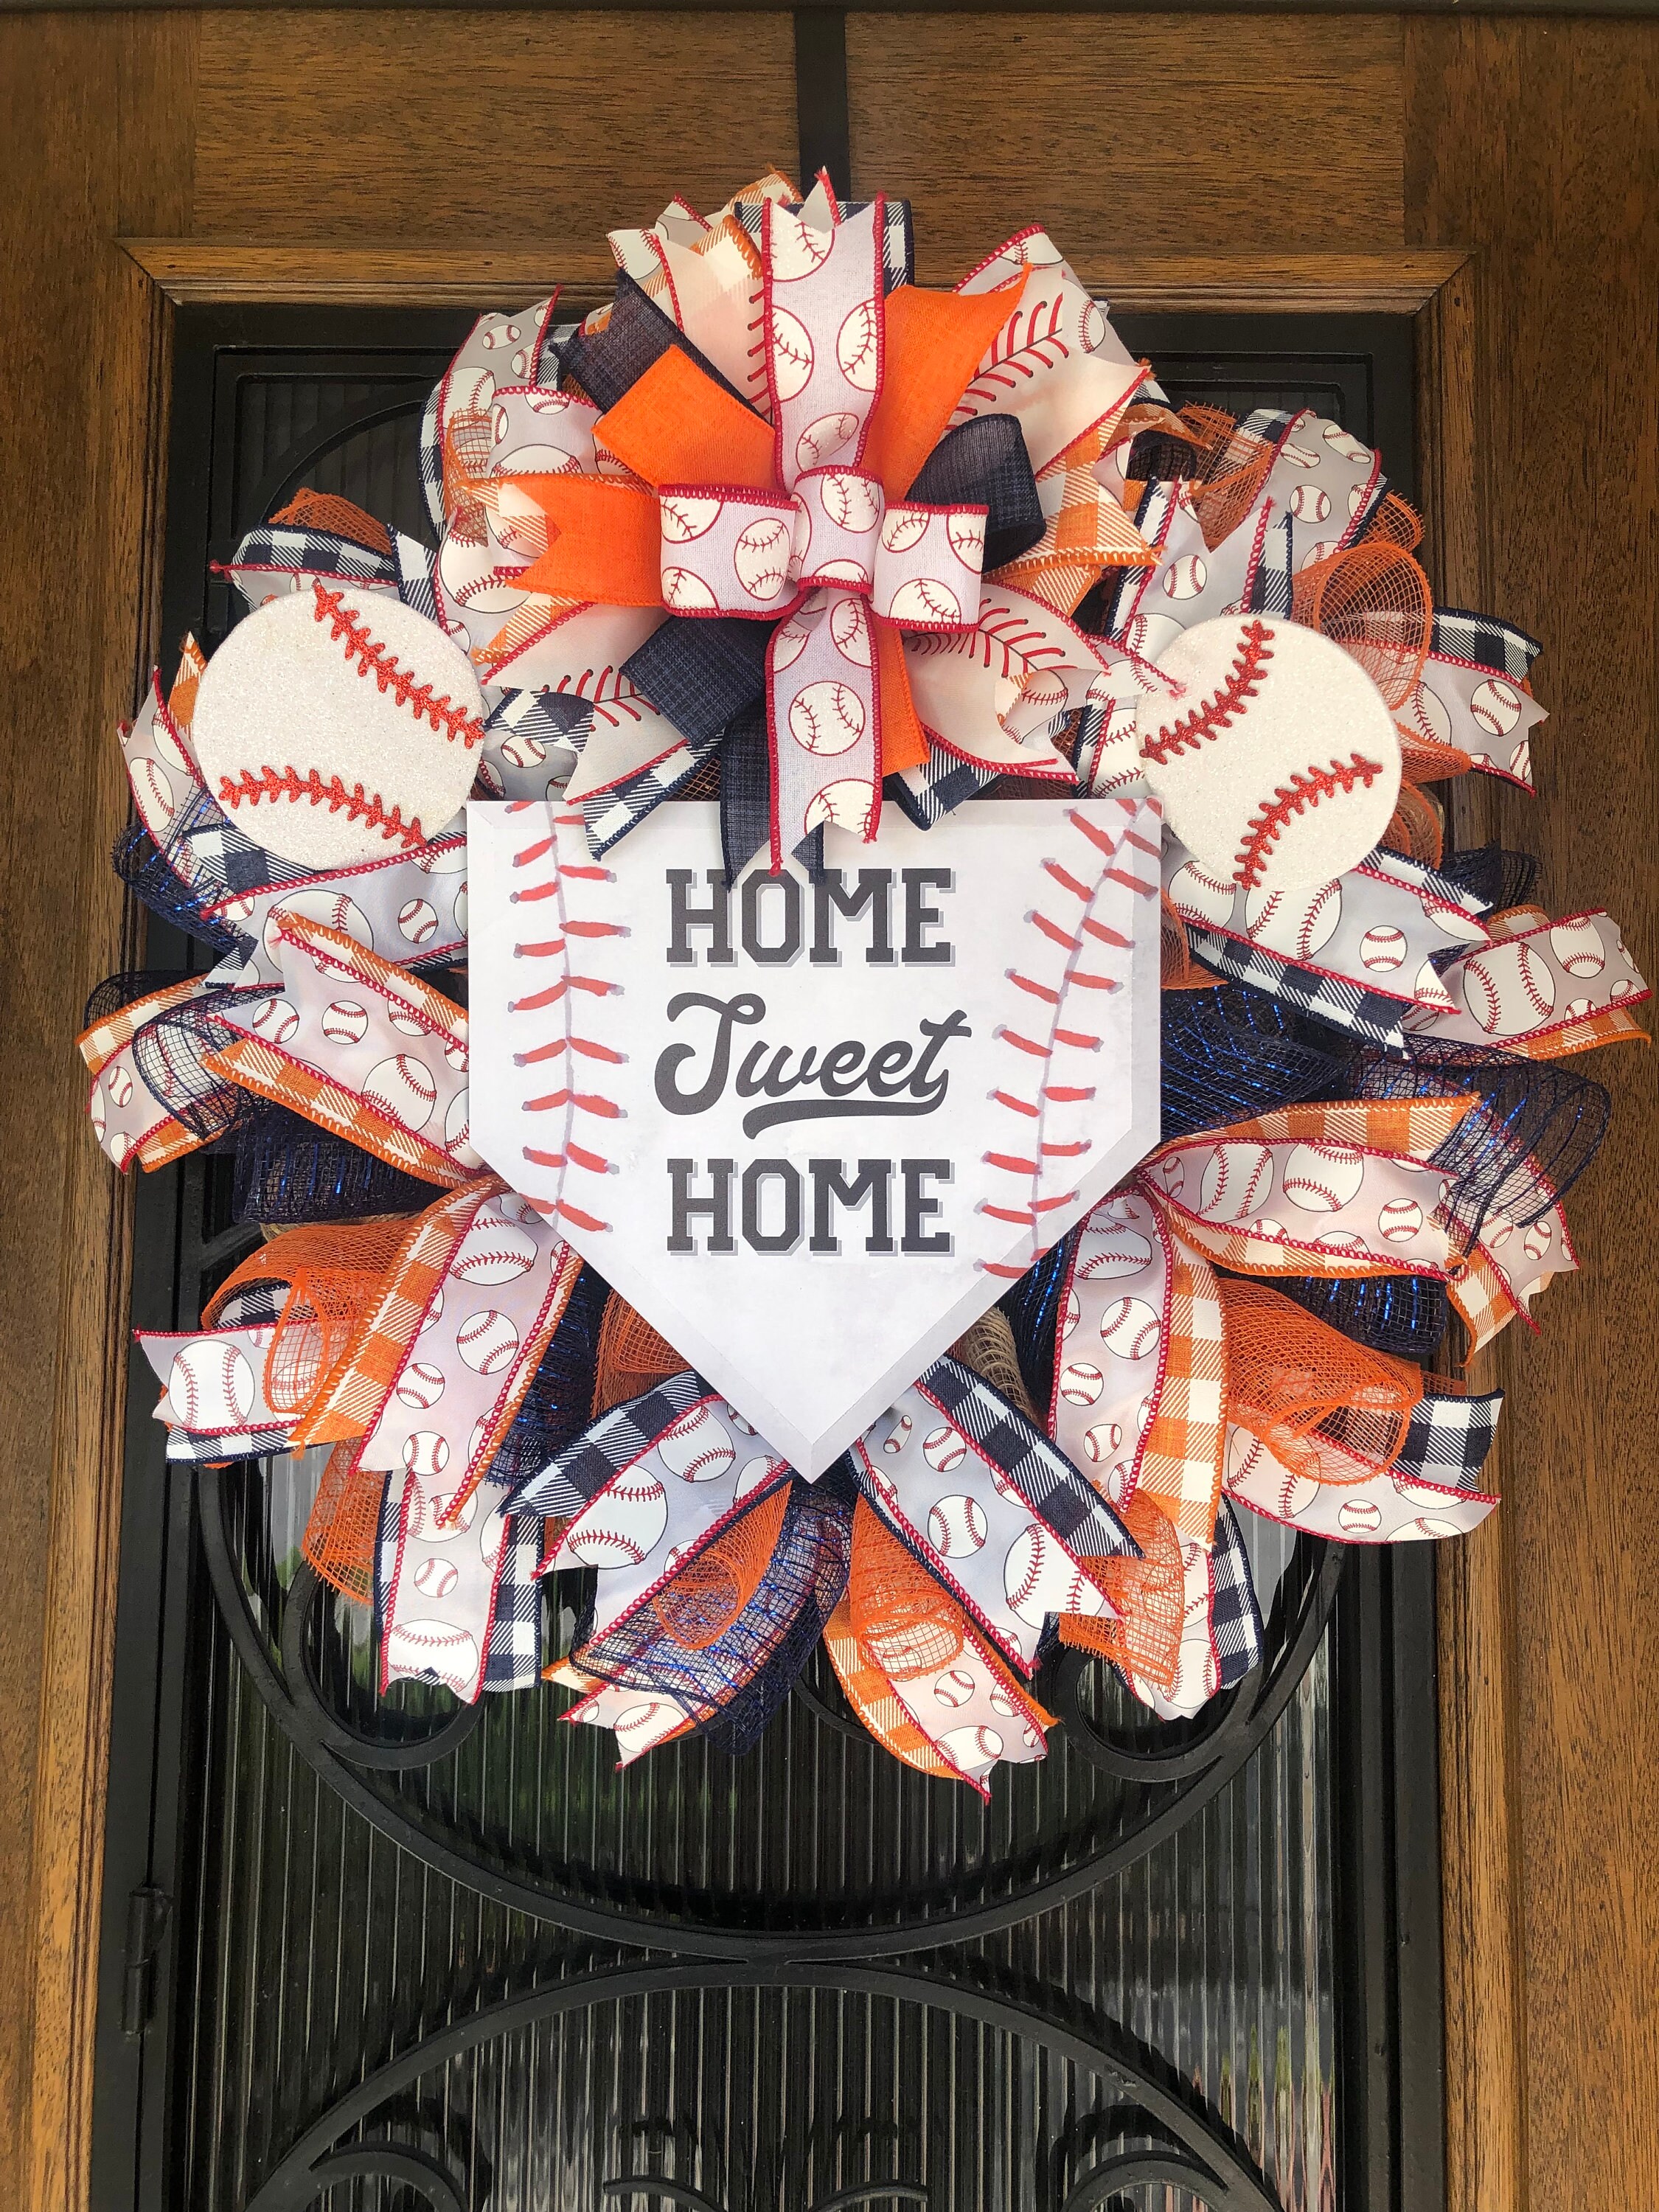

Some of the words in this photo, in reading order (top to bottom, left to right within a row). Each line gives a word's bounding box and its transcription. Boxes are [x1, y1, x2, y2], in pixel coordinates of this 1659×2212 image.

[666, 869, 956, 967] HOME
[654, 992, 972, 1140] Sweet
[667, 1158, 955, 1256] HOME
